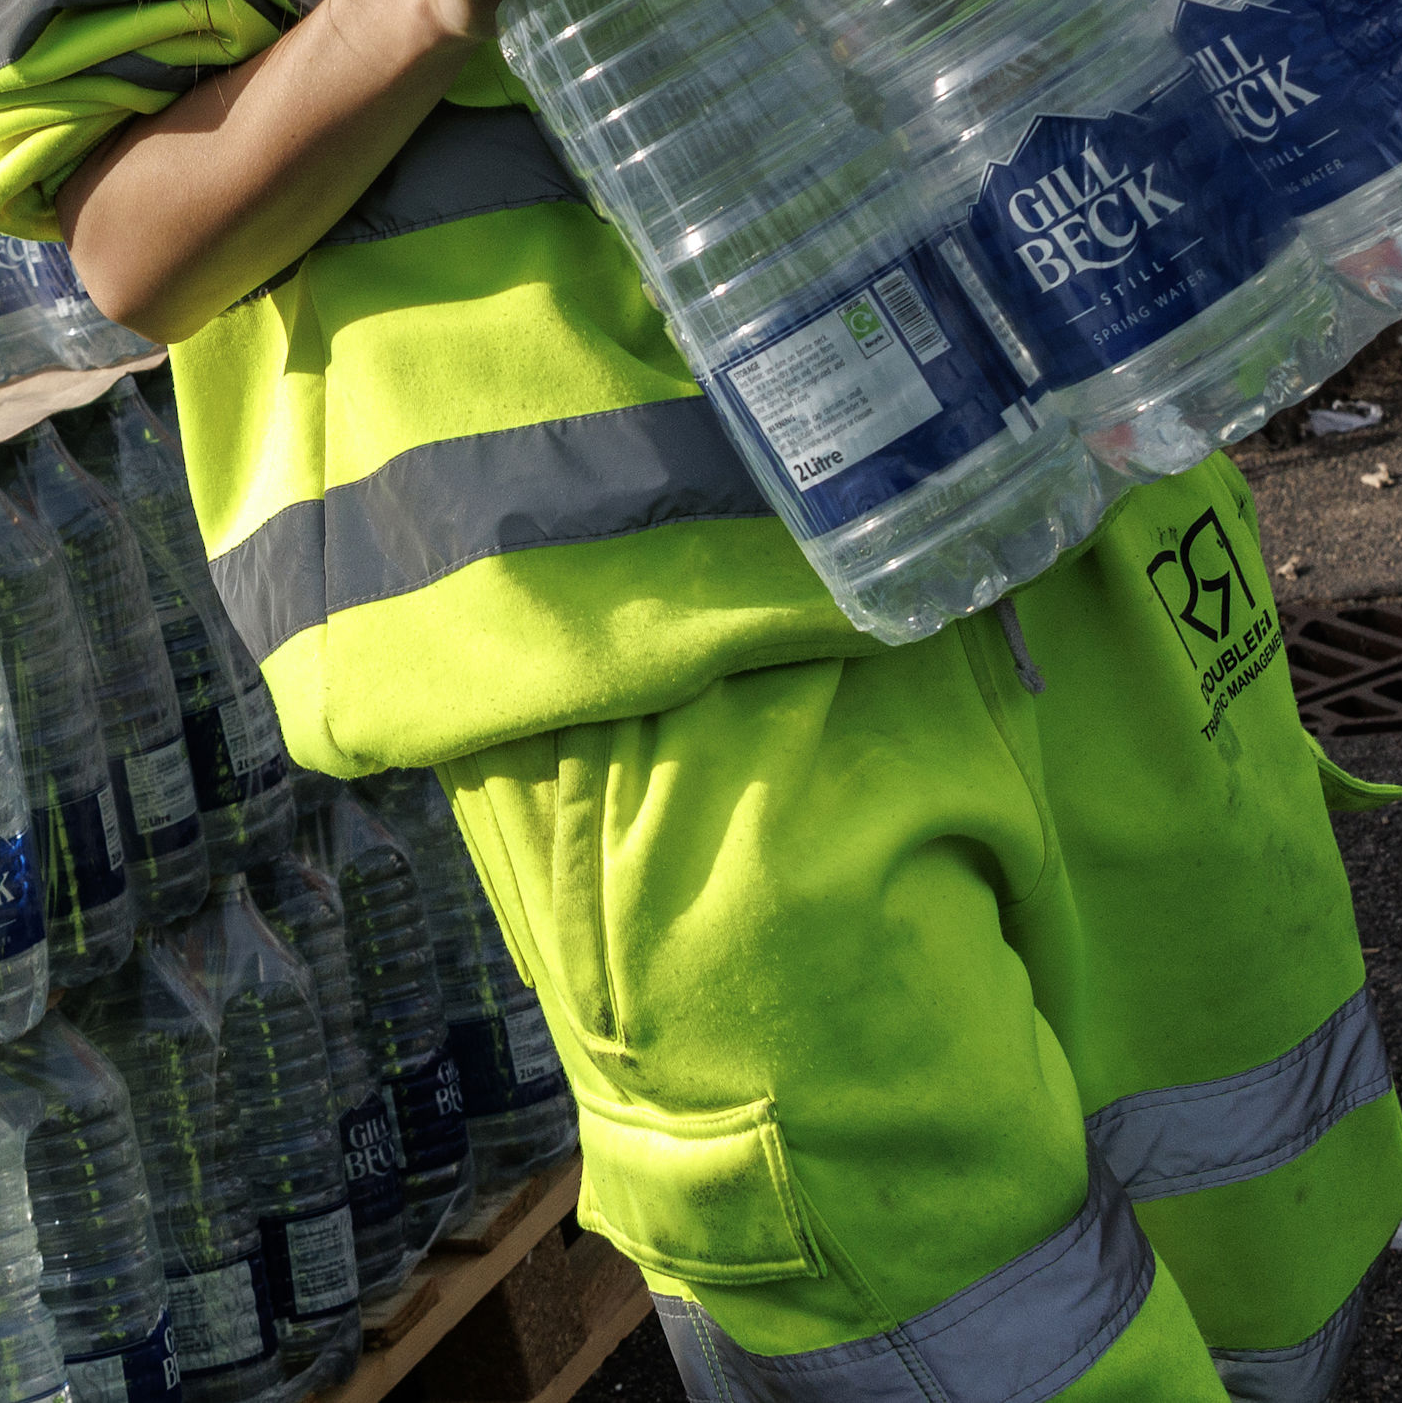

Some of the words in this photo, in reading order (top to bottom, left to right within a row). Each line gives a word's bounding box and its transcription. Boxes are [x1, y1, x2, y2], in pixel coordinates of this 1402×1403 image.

[1194, 34, 1265, 92] ILL
[1214, 54, 1321, 143] ECK
[1008, 146, 1129, 233] GILL
[1301, 158, 1345, 187] WATER
[1014, 163, 1185, 293] BECK
[1093, 305, 1150, 345] SPRING
[1155, 268, 1207, 308] WATER
[1100, 261, 1164, 305] STILL
[793, 464, 809, 483] 2
[803, 449, 844, 479] Litre
[1200, 692, 1229, 742] TRAFFIC
[518, 1070, 526, 1080] 2
[526, 1066, 545, 1078] Litre
